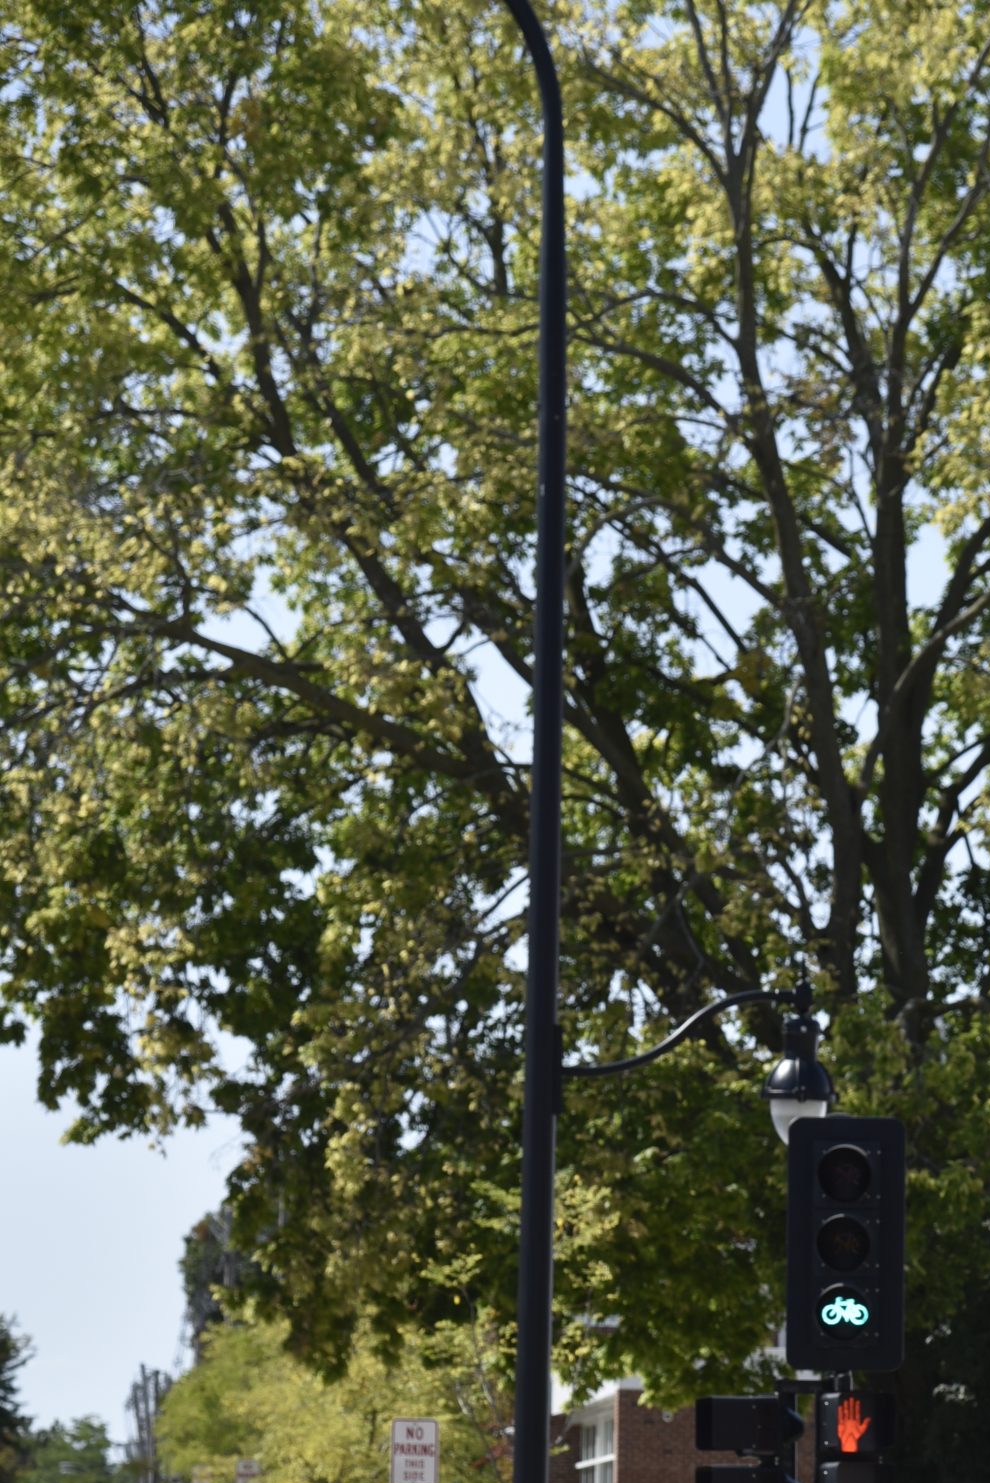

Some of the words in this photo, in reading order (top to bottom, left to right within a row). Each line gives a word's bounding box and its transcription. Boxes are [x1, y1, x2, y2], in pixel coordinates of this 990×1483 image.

[406, 1427, 424, 1440] NO
[394, 1443, 435, 1457] PARKING
[405, 1460, 424, 1469] THIS
[404, 1471, 425, 1480] SIDE
